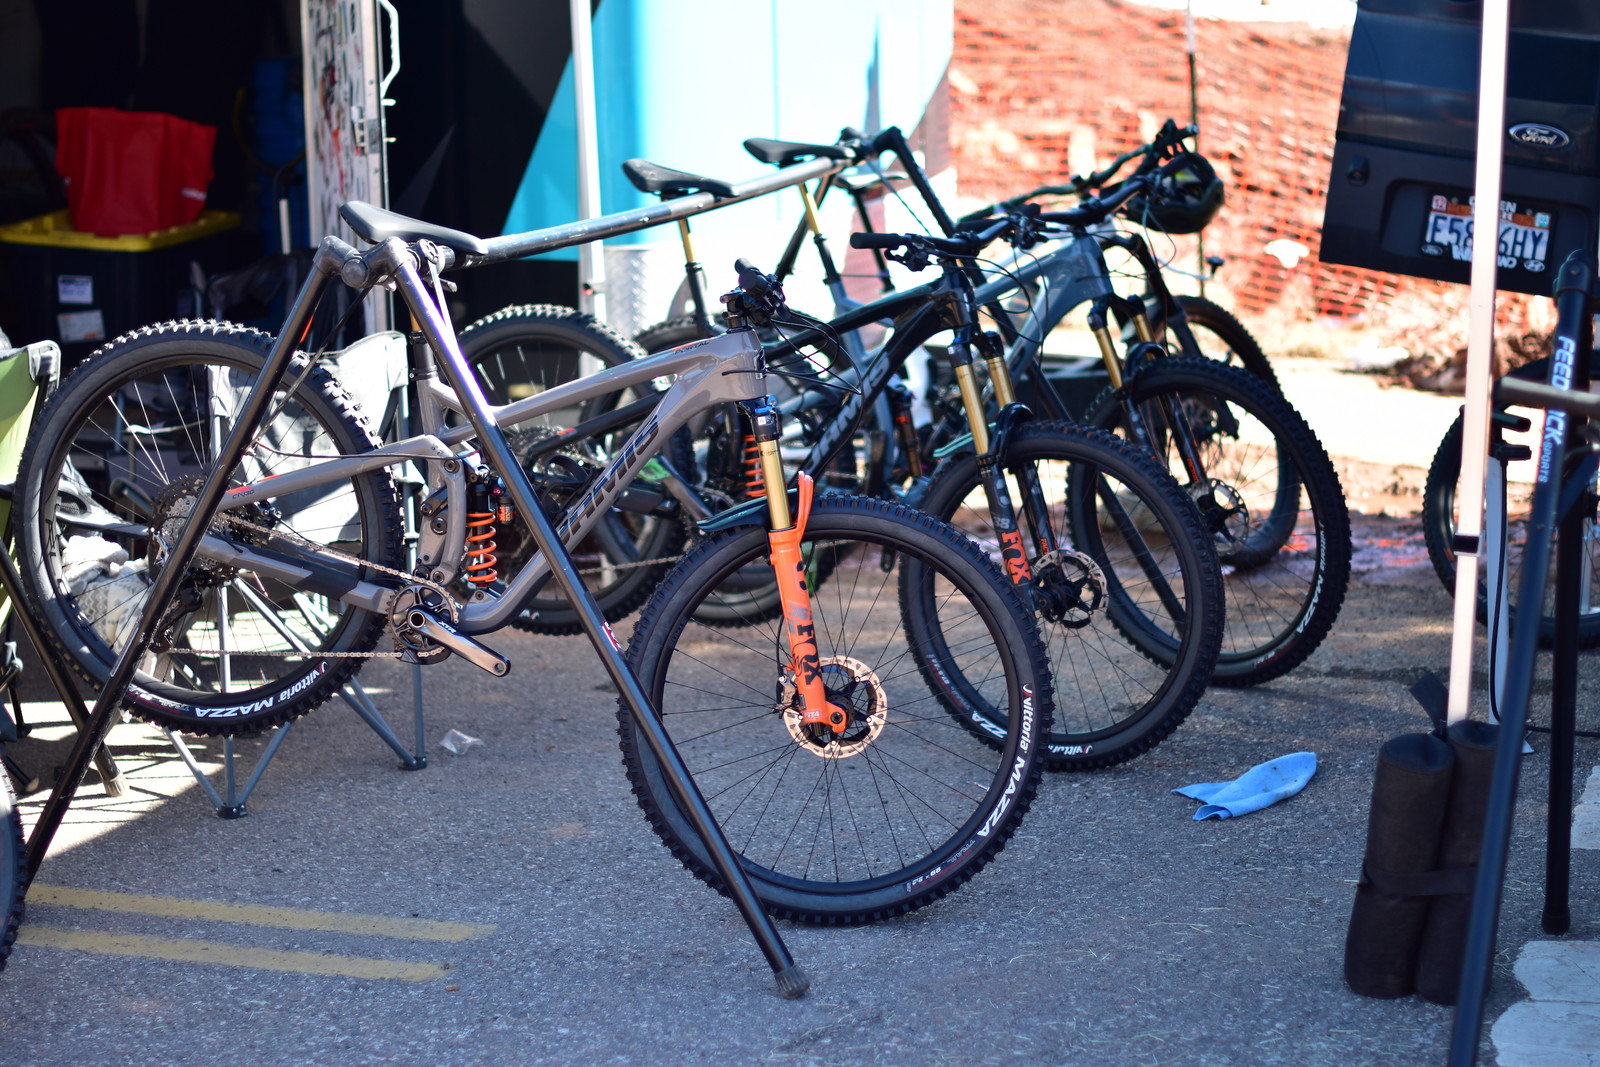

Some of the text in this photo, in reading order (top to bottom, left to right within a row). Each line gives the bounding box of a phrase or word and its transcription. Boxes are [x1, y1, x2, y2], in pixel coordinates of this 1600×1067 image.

[1538, 336, 1576, 483] FEEDCK SPORTS
[1001, 529, 1033, 585] FOX
[438, 620, 457, 634] XTR
[1296, 574, 1324, 634] MAZZA
[793, 619, 823, 686] FOX
[195, 697, 274, 718] MAZZA
[280, 668, 320, 702] vittoria
[971, 710, 1008, 739] ZZA
[1020, 697, 1034, 751] vittoria
[1048, 744, 1083, 756] vittor
[976, 755, 1025, 838] MAZZA
